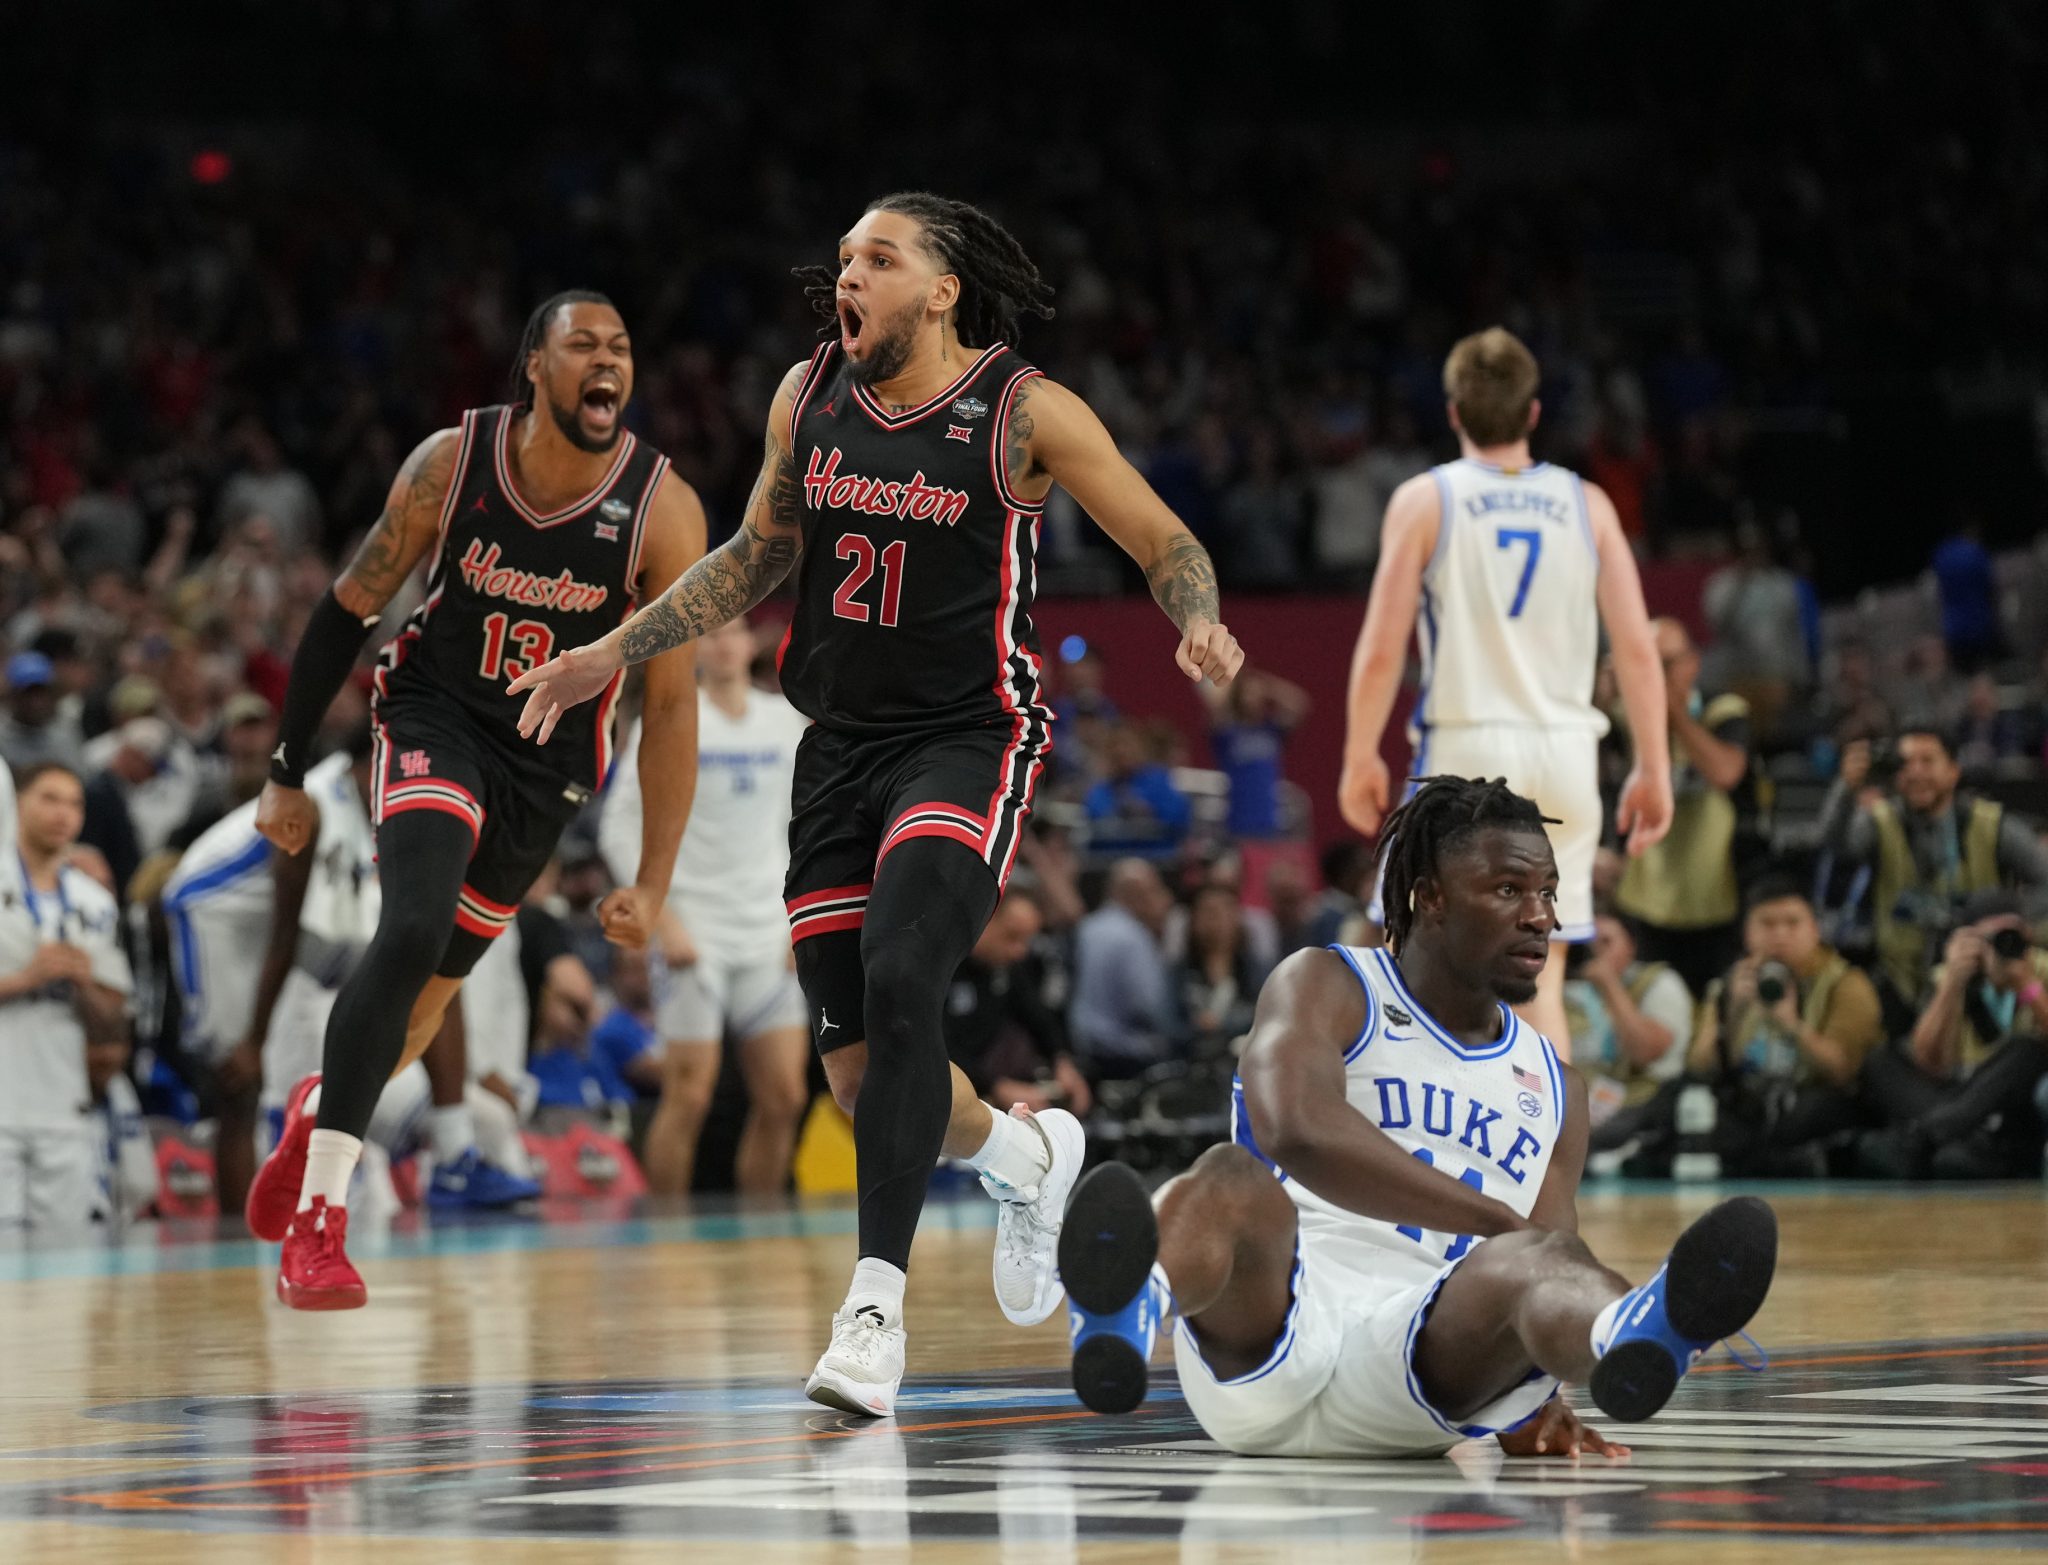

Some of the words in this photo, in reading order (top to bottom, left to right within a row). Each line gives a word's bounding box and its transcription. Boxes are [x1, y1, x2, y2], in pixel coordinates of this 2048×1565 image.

[955, 403, 971, 411] FINAL
[970, 405, 987, 413] FOUR
[804, 445, 970, 527] Houston
[459, 537, 608, 614] Houston
[833, 533, 907, 628] 21
[1497, 528, 1542, 620] 7
[479, 611, 555, 688] 13
[1373, 1077, 1542, 1185] DUKE
